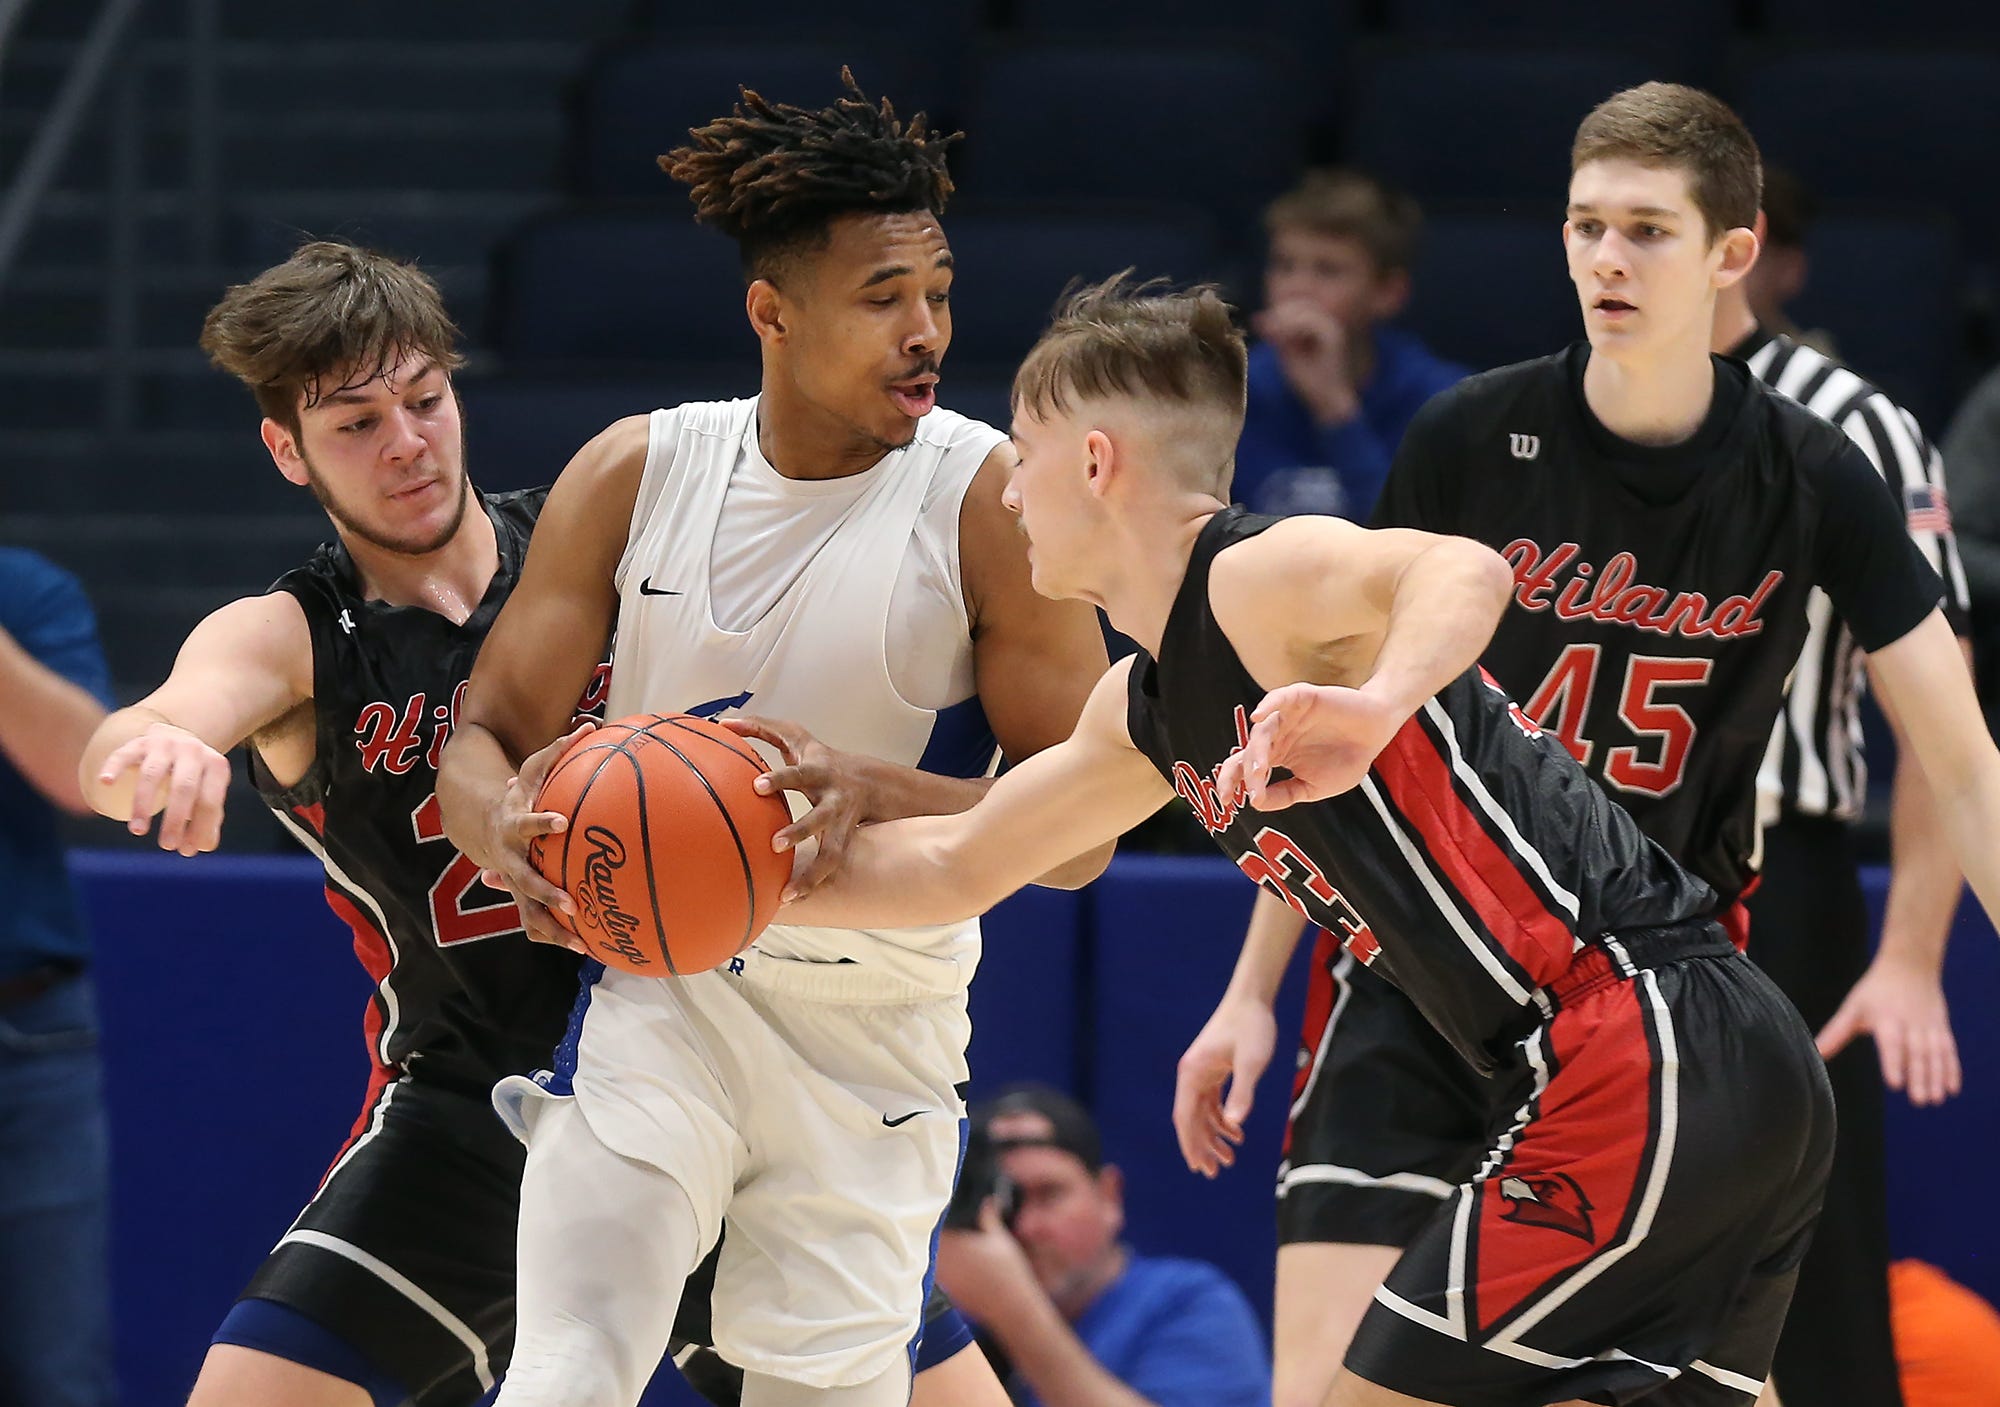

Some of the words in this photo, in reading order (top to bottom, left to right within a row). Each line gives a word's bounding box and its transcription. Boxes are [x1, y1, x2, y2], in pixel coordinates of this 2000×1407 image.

[1500, 537, 1785, 639] Hiland
[1520, 642, 1715, 799] 45
[583, 825, 652, 968] Rawlings
